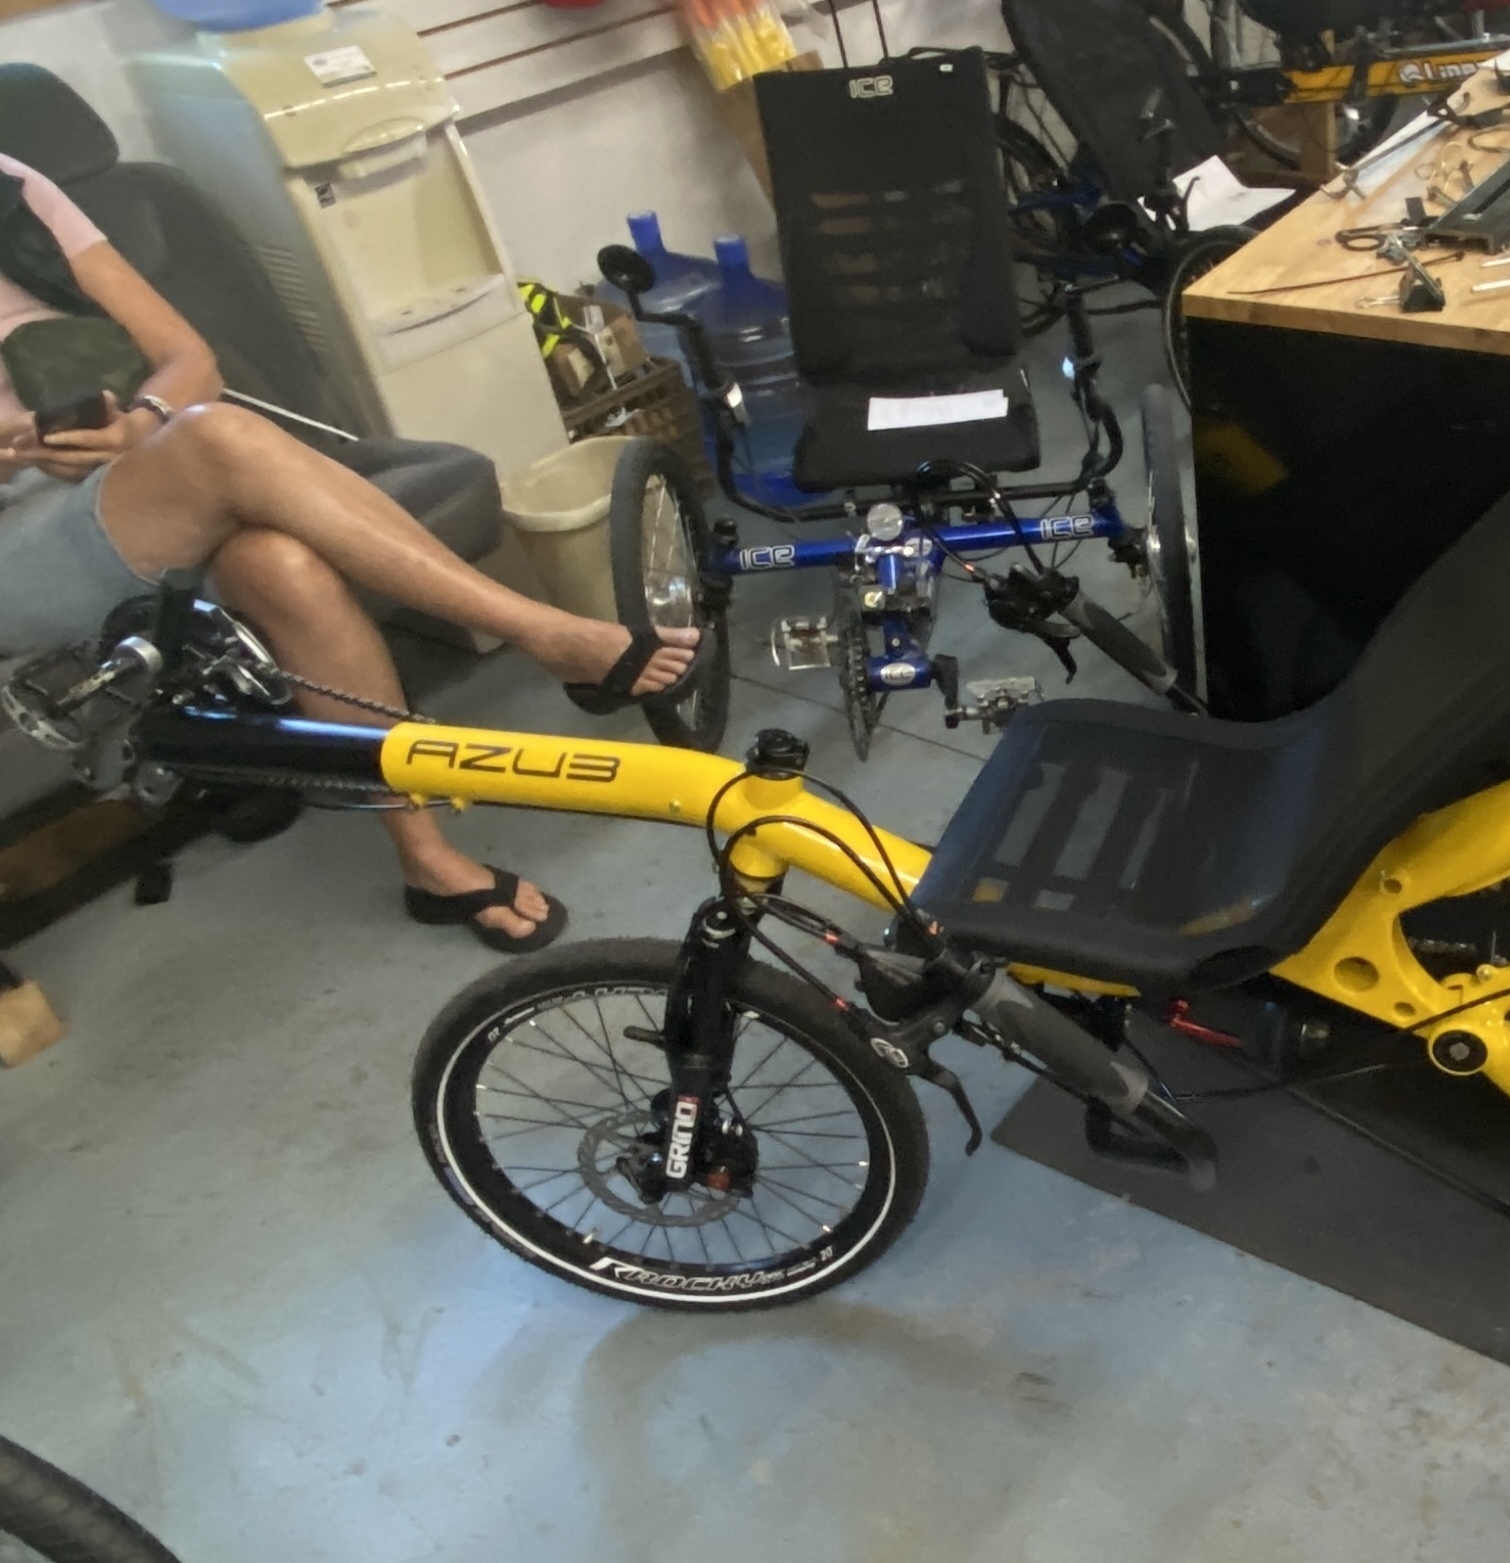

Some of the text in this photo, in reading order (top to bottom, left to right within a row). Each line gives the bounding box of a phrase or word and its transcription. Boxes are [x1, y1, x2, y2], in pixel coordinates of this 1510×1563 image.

[849, 75, 893, 99] ICE
[1040, 514, 1094, 540] ICE
[739, 544, 795, 570] ICE
